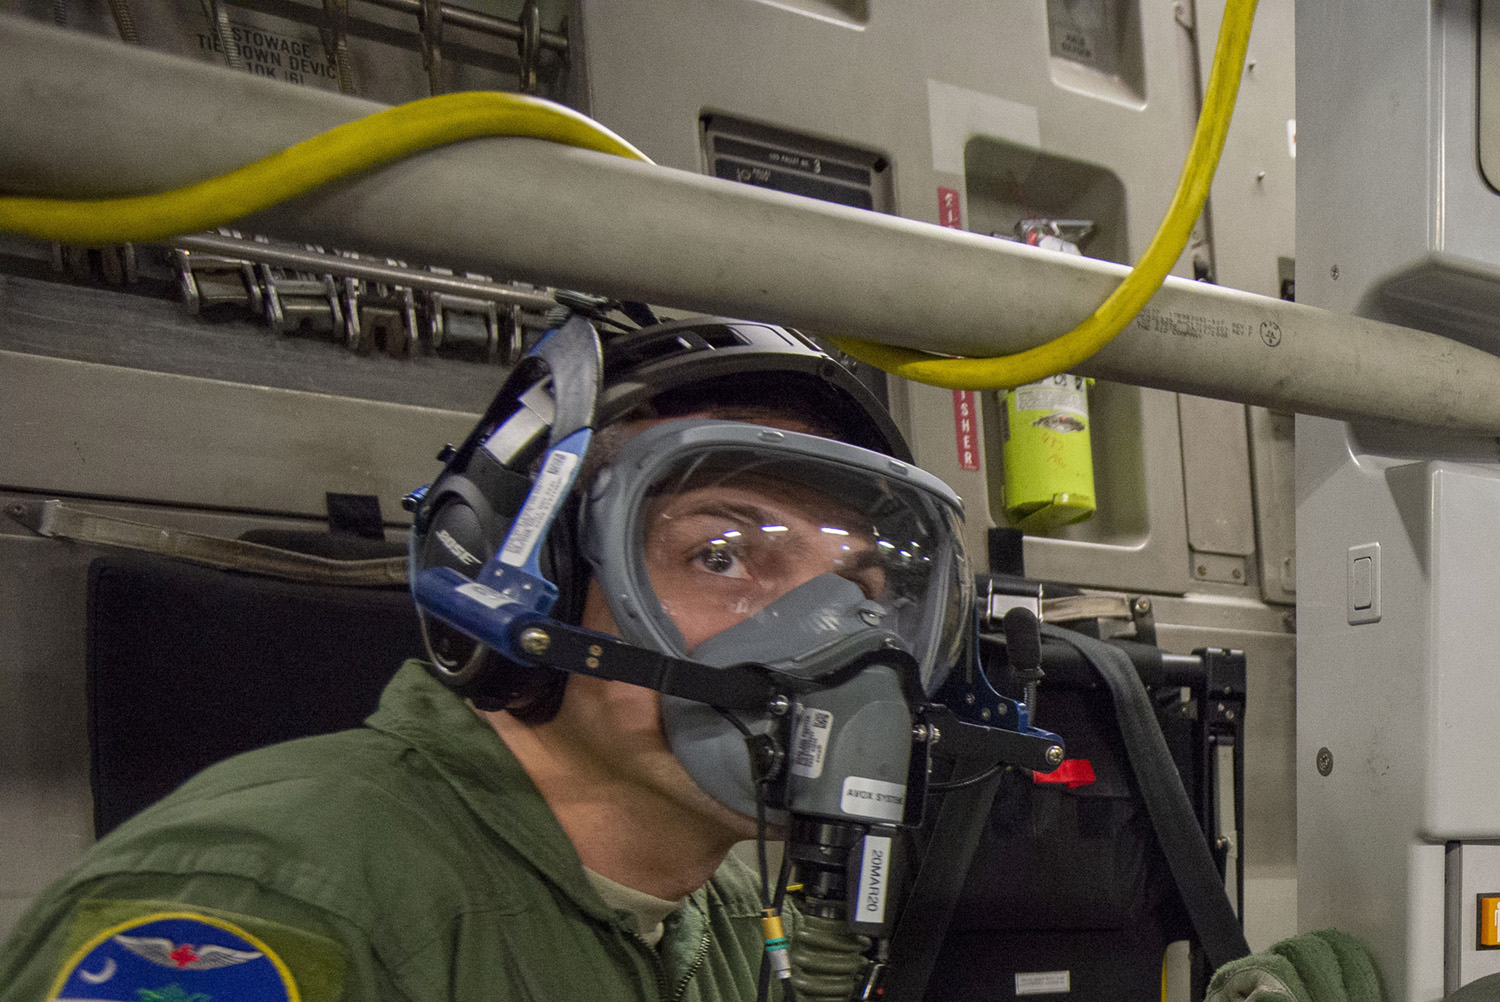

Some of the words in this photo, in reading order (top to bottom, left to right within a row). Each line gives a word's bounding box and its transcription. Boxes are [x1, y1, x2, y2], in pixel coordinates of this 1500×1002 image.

[198, 34, 224, 52] TIE
[290, 56, 336, 79] DEVIC
[232, 28, 312, 59] STOWAGE
[866, 849, 884, 912] 20MAR20
